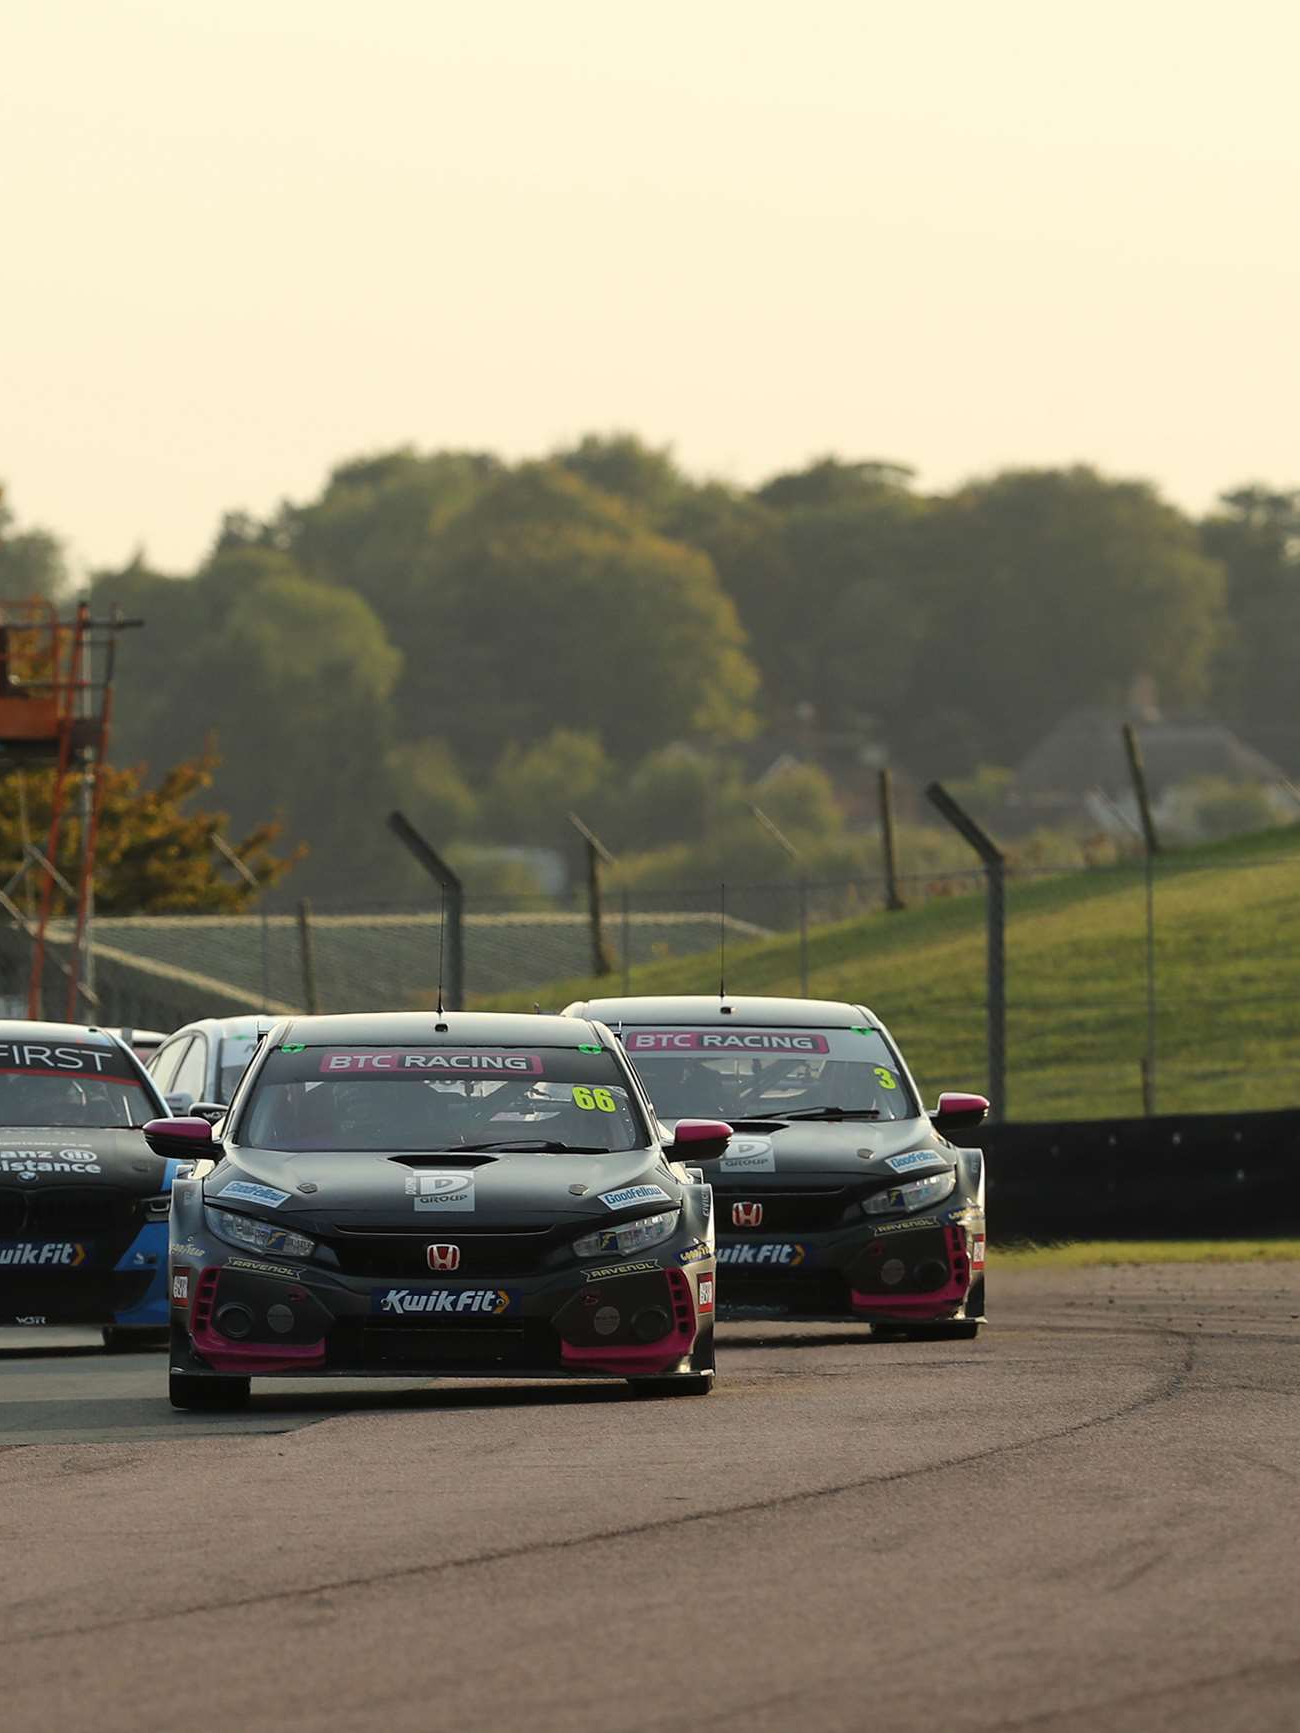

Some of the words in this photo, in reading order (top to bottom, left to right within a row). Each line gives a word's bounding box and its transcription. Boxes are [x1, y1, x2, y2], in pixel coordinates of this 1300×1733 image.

[636, 1034, 692, 1047] BTC
[703, 1035, 813, 1049] RACING
[329, 1055, 392, 1069] BTC
[405, 1055, 527, 1070] RACING
[873, 1068, 896, 1089] 3
[572, 1086, 616, 1112] 66
[420, 1194, 468, 1203] GROUP
[604, 1182, 662, 1205] GoodFellow
[232, 1260, 297, 1277] RAVENOL
[592, 1260, 656, 1278] RAVENOL
